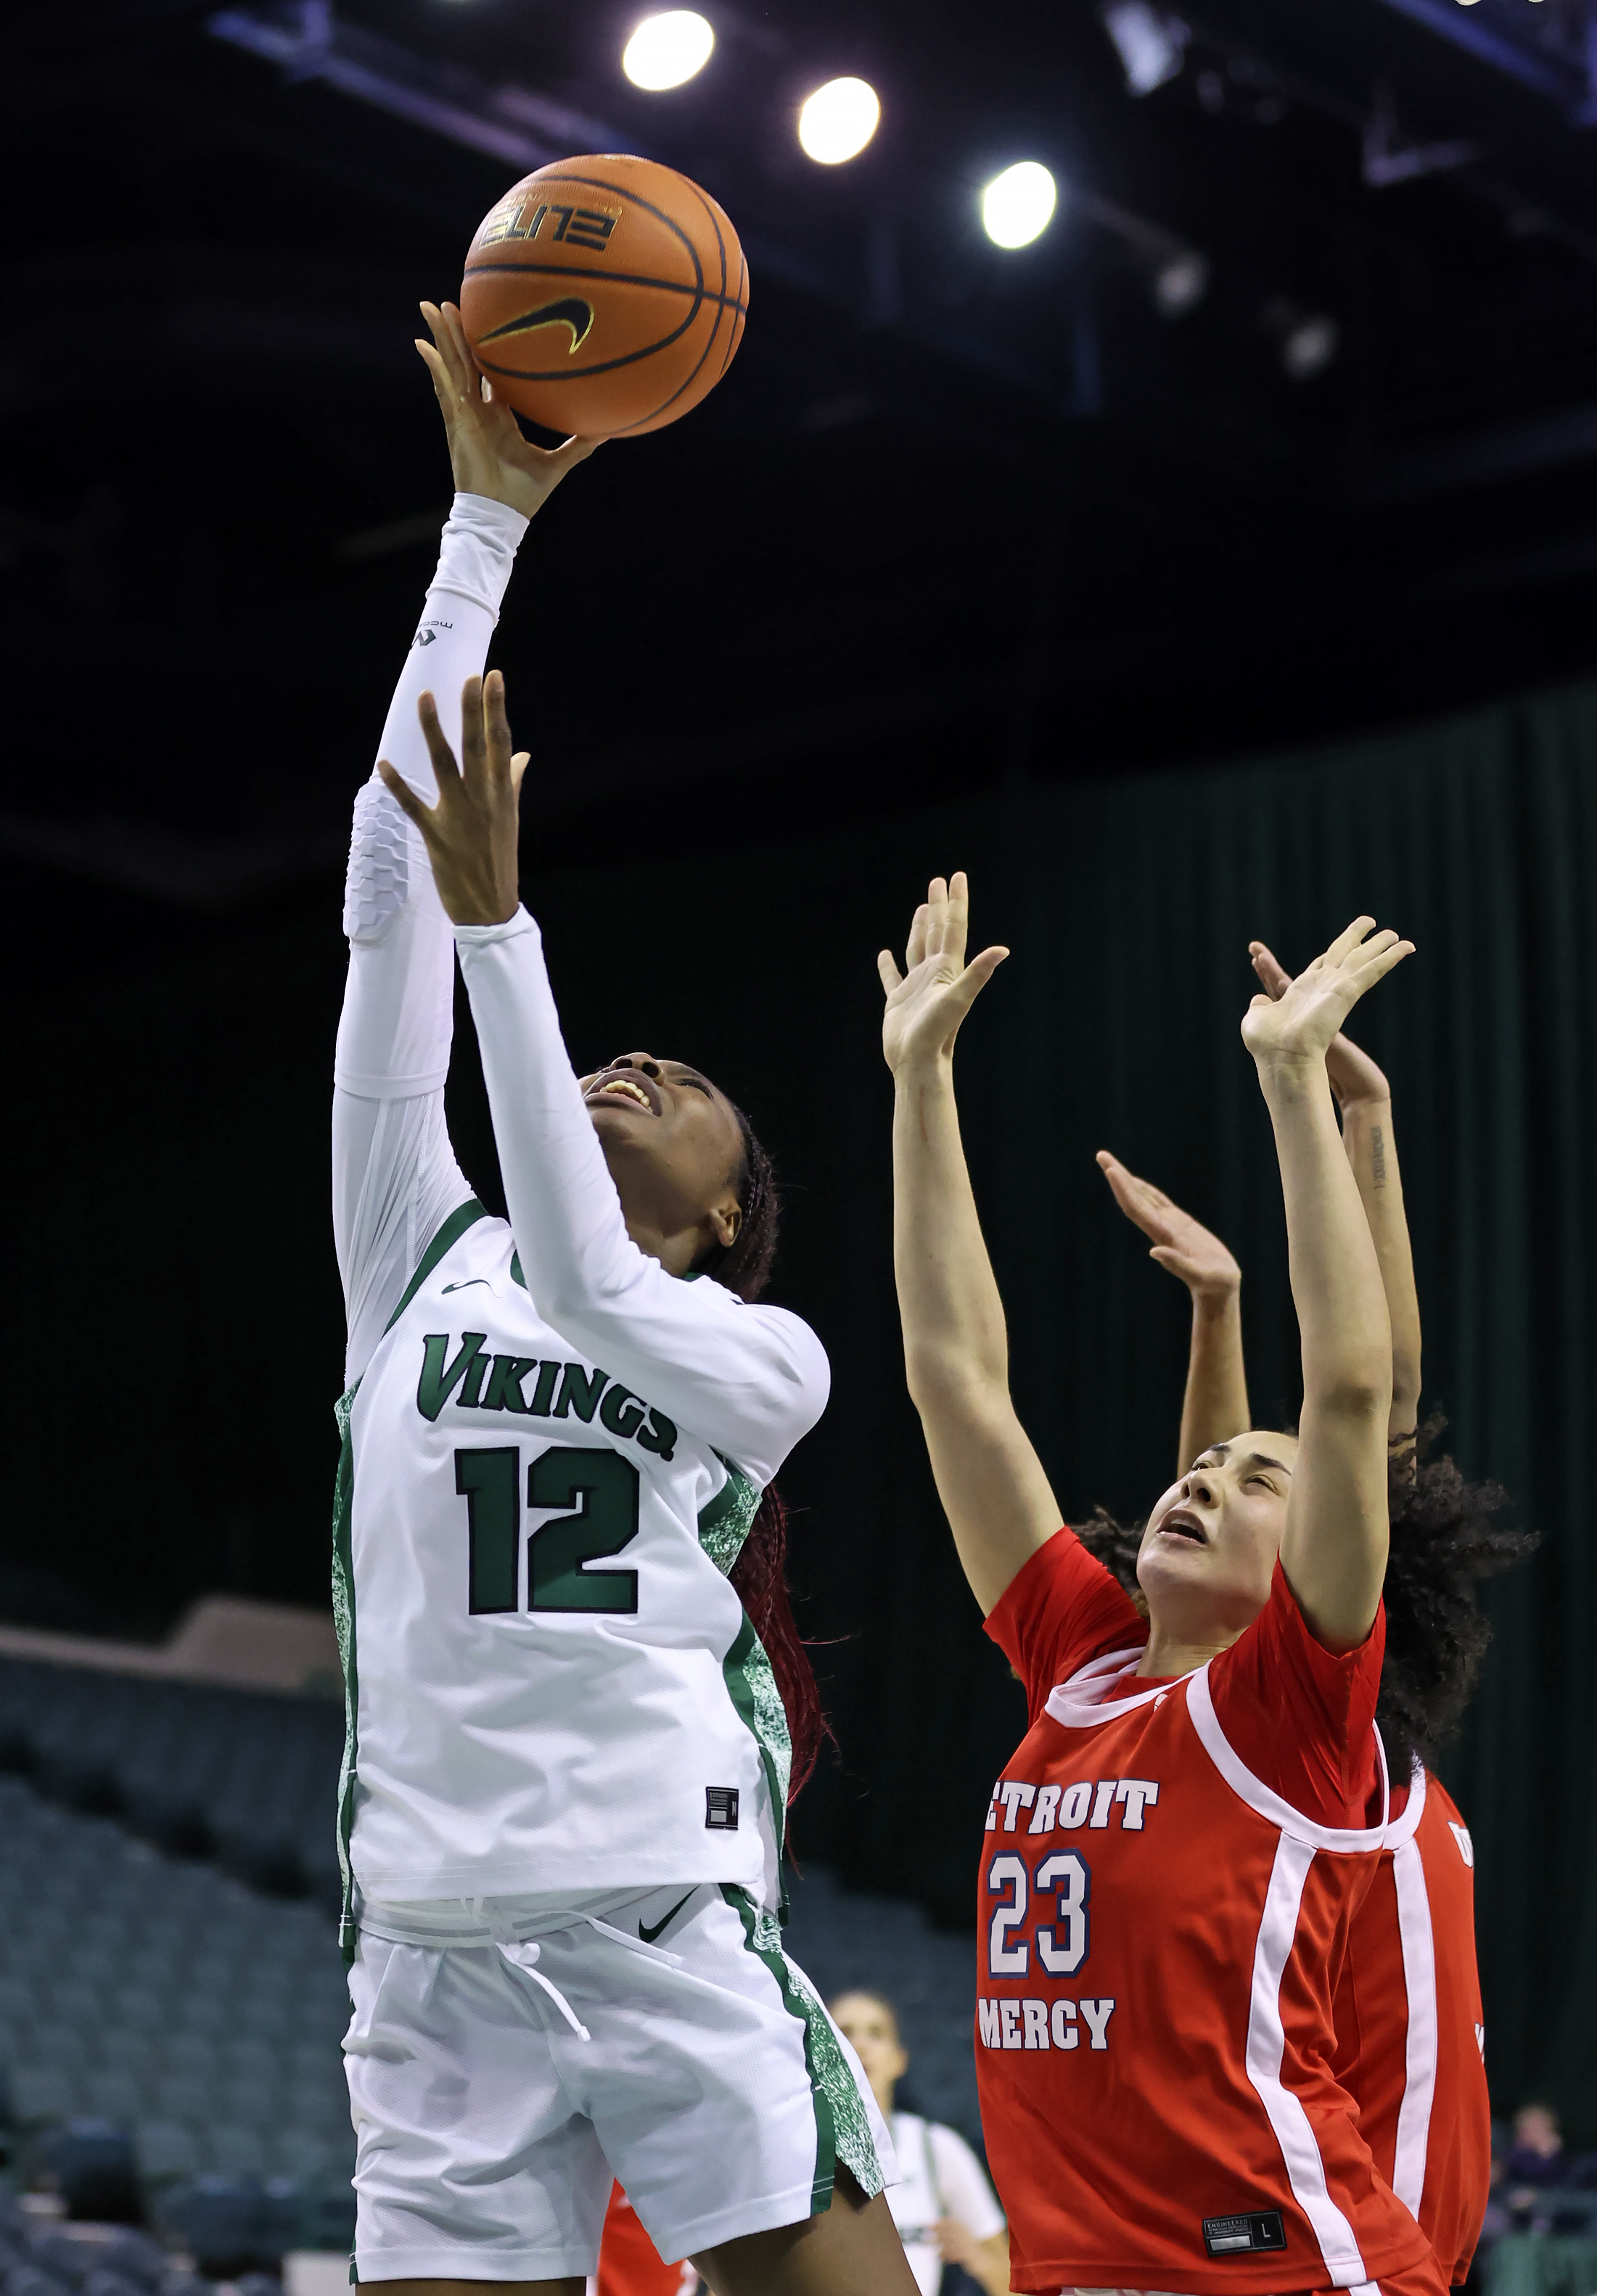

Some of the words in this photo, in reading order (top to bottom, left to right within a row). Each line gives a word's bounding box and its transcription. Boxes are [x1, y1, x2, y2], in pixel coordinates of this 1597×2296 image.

[478, 202, 618, 252] ELITE
[416, 1332, 678, 1462] VIKINGS
[454, 1446, 639, 1615] 12
[985, 1779, 1159, 1834] ETROIT
[987, 1848, 1092, 1980] 23
[978, 1997, 1116, 2050] MERCY
[1207, 2218, 1248, 2229] ENGINEERED
[1261, 2223, 1271, 2238] L
